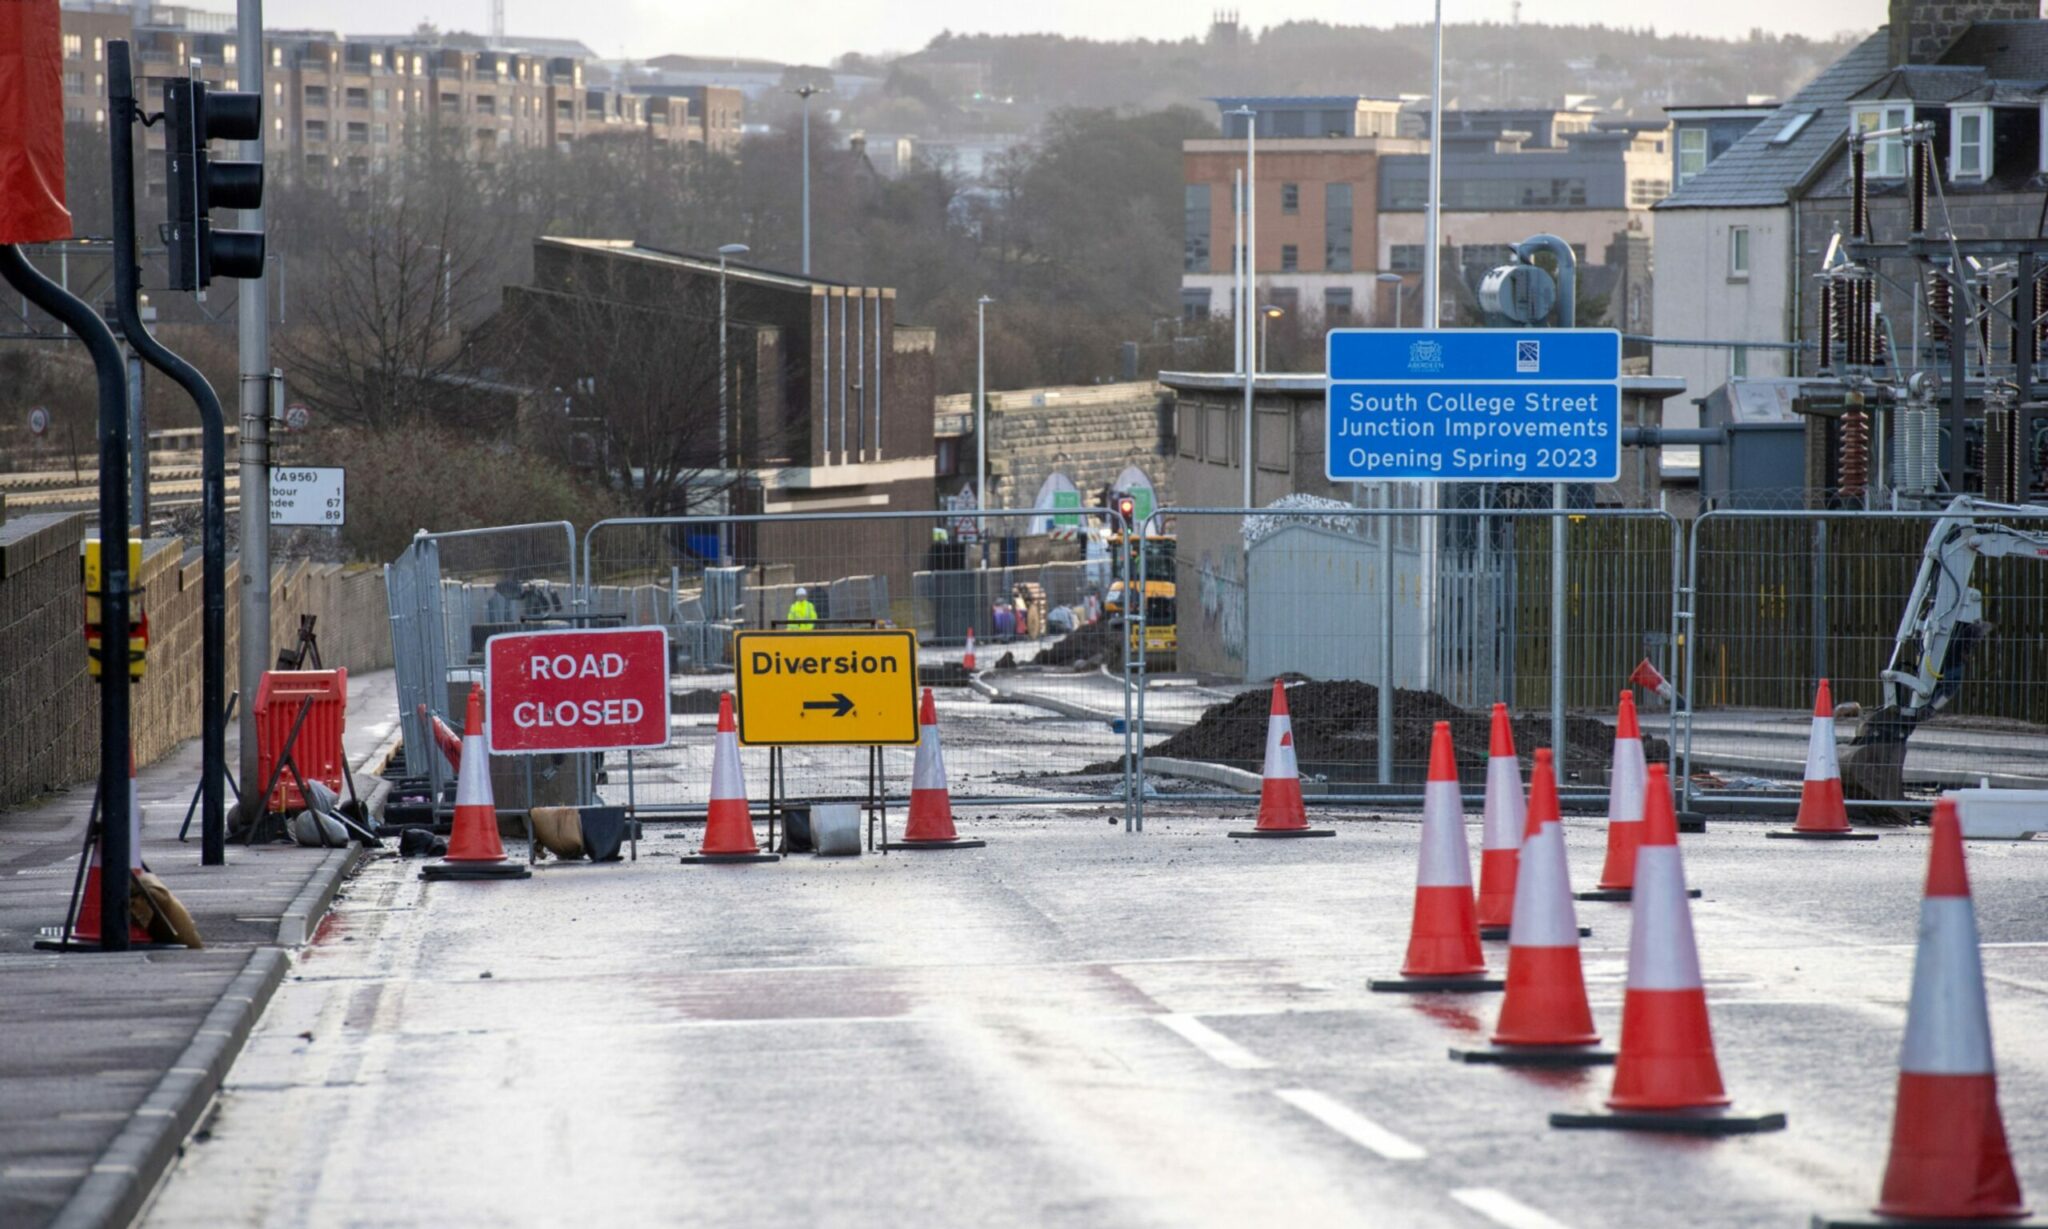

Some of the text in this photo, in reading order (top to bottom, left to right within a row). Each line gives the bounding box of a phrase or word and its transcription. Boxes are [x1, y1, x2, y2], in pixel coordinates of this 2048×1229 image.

[172, 160, 178, 173] 5
[173, 229, 178, 240] 6
[1350, 392, 1598, 416] South College Street
[1338, 417, 1608, 440] Junction Improvements
[1349, 447, 1597, 471] Opening Spring 2023
[274, 472, 318, 483] (A956)
[271, 487, 341, 496] bour 1
[326, 498, 341, 508] 67
[325, 511, 341, 519] 89
[531, 653, 623, 680] ROAD
[752, 651, 898, 675] Diversion
[513, 698, 643, 728] CLOSED
